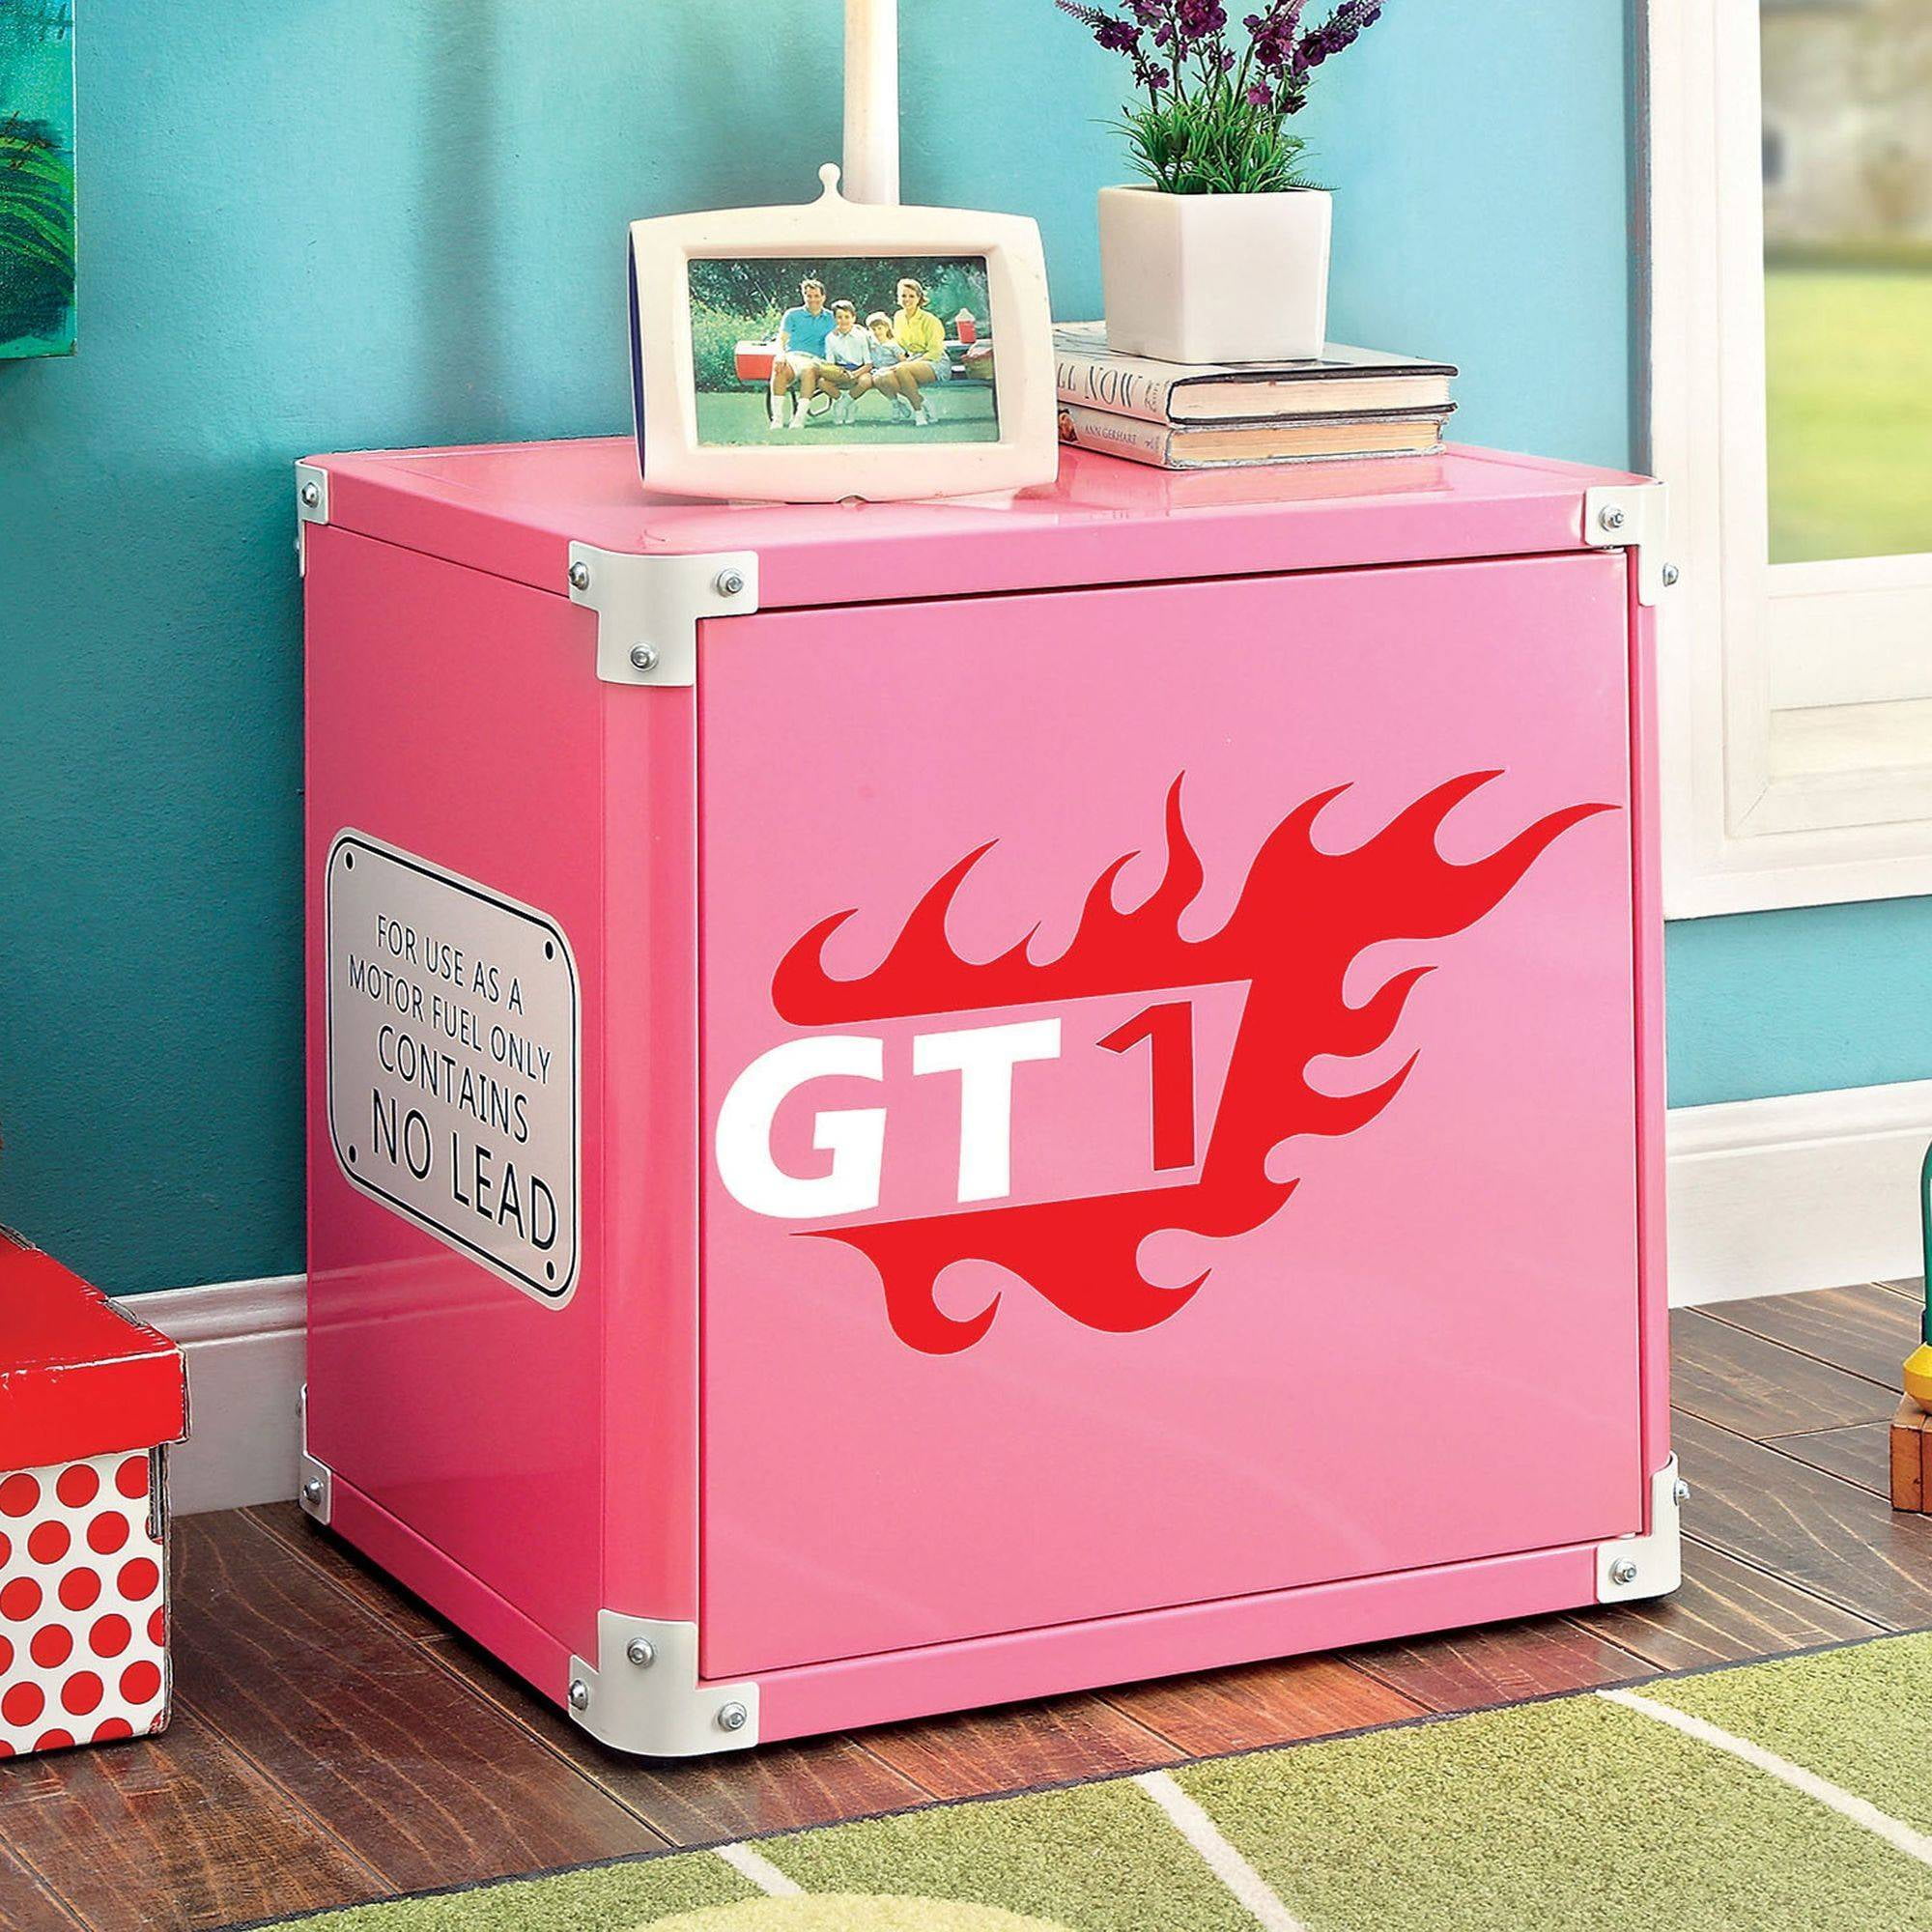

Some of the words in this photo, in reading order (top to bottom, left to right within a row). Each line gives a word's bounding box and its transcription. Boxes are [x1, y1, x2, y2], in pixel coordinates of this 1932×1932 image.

[1085, 365, 1143, 408] NOW
[349, 954, 425, 1023] MOTOR
[432, 995, 482, 1053] FUEL
[491, 1025, 552, 1085] ONLY
[378, 914, 417, 964] FOR
[425, 937, 464, 987] USE
[472, 960, 500, 1003] AS
[508, 979, 524, 1016] A
[378, 1024, 530, 1145] CONTAINS
[715, 1017, 1062, 1219] GT
[1094, 1000, 1196, 1172] 1
[373, 1088, 431, 1180] NO
[451, 1131, 557, 1252] LEAD
